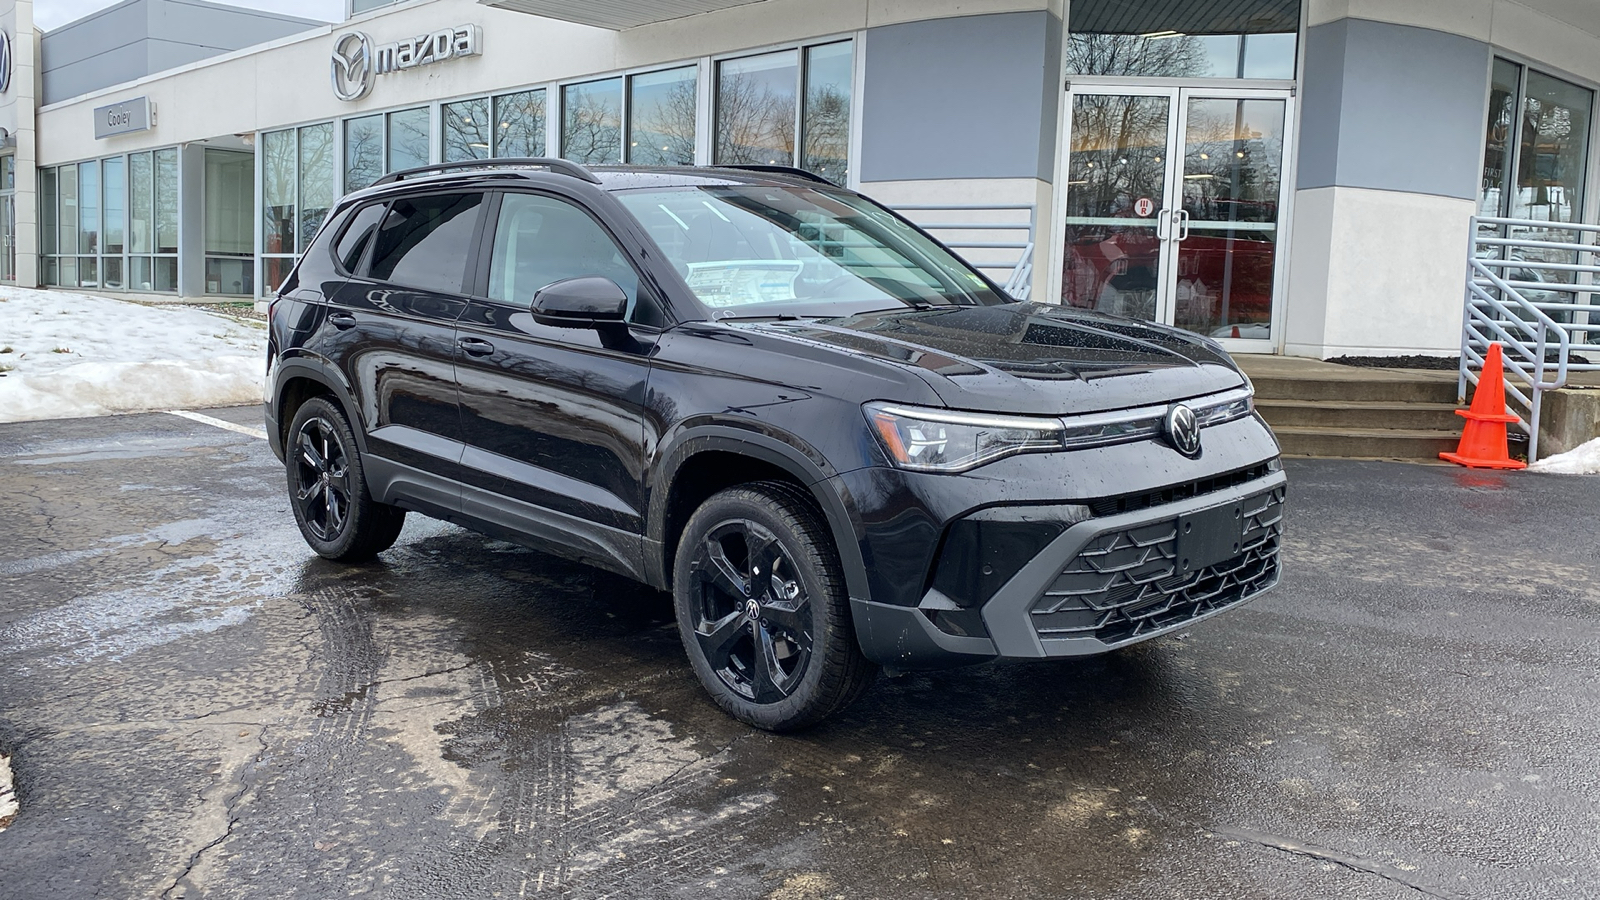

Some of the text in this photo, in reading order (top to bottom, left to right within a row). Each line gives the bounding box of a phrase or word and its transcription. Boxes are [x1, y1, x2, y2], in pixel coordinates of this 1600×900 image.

[107, 105, 131, 128] Cooley
[1484, 167, 1502, 178] FIRST
[1140, 207, 1147, 215] R
